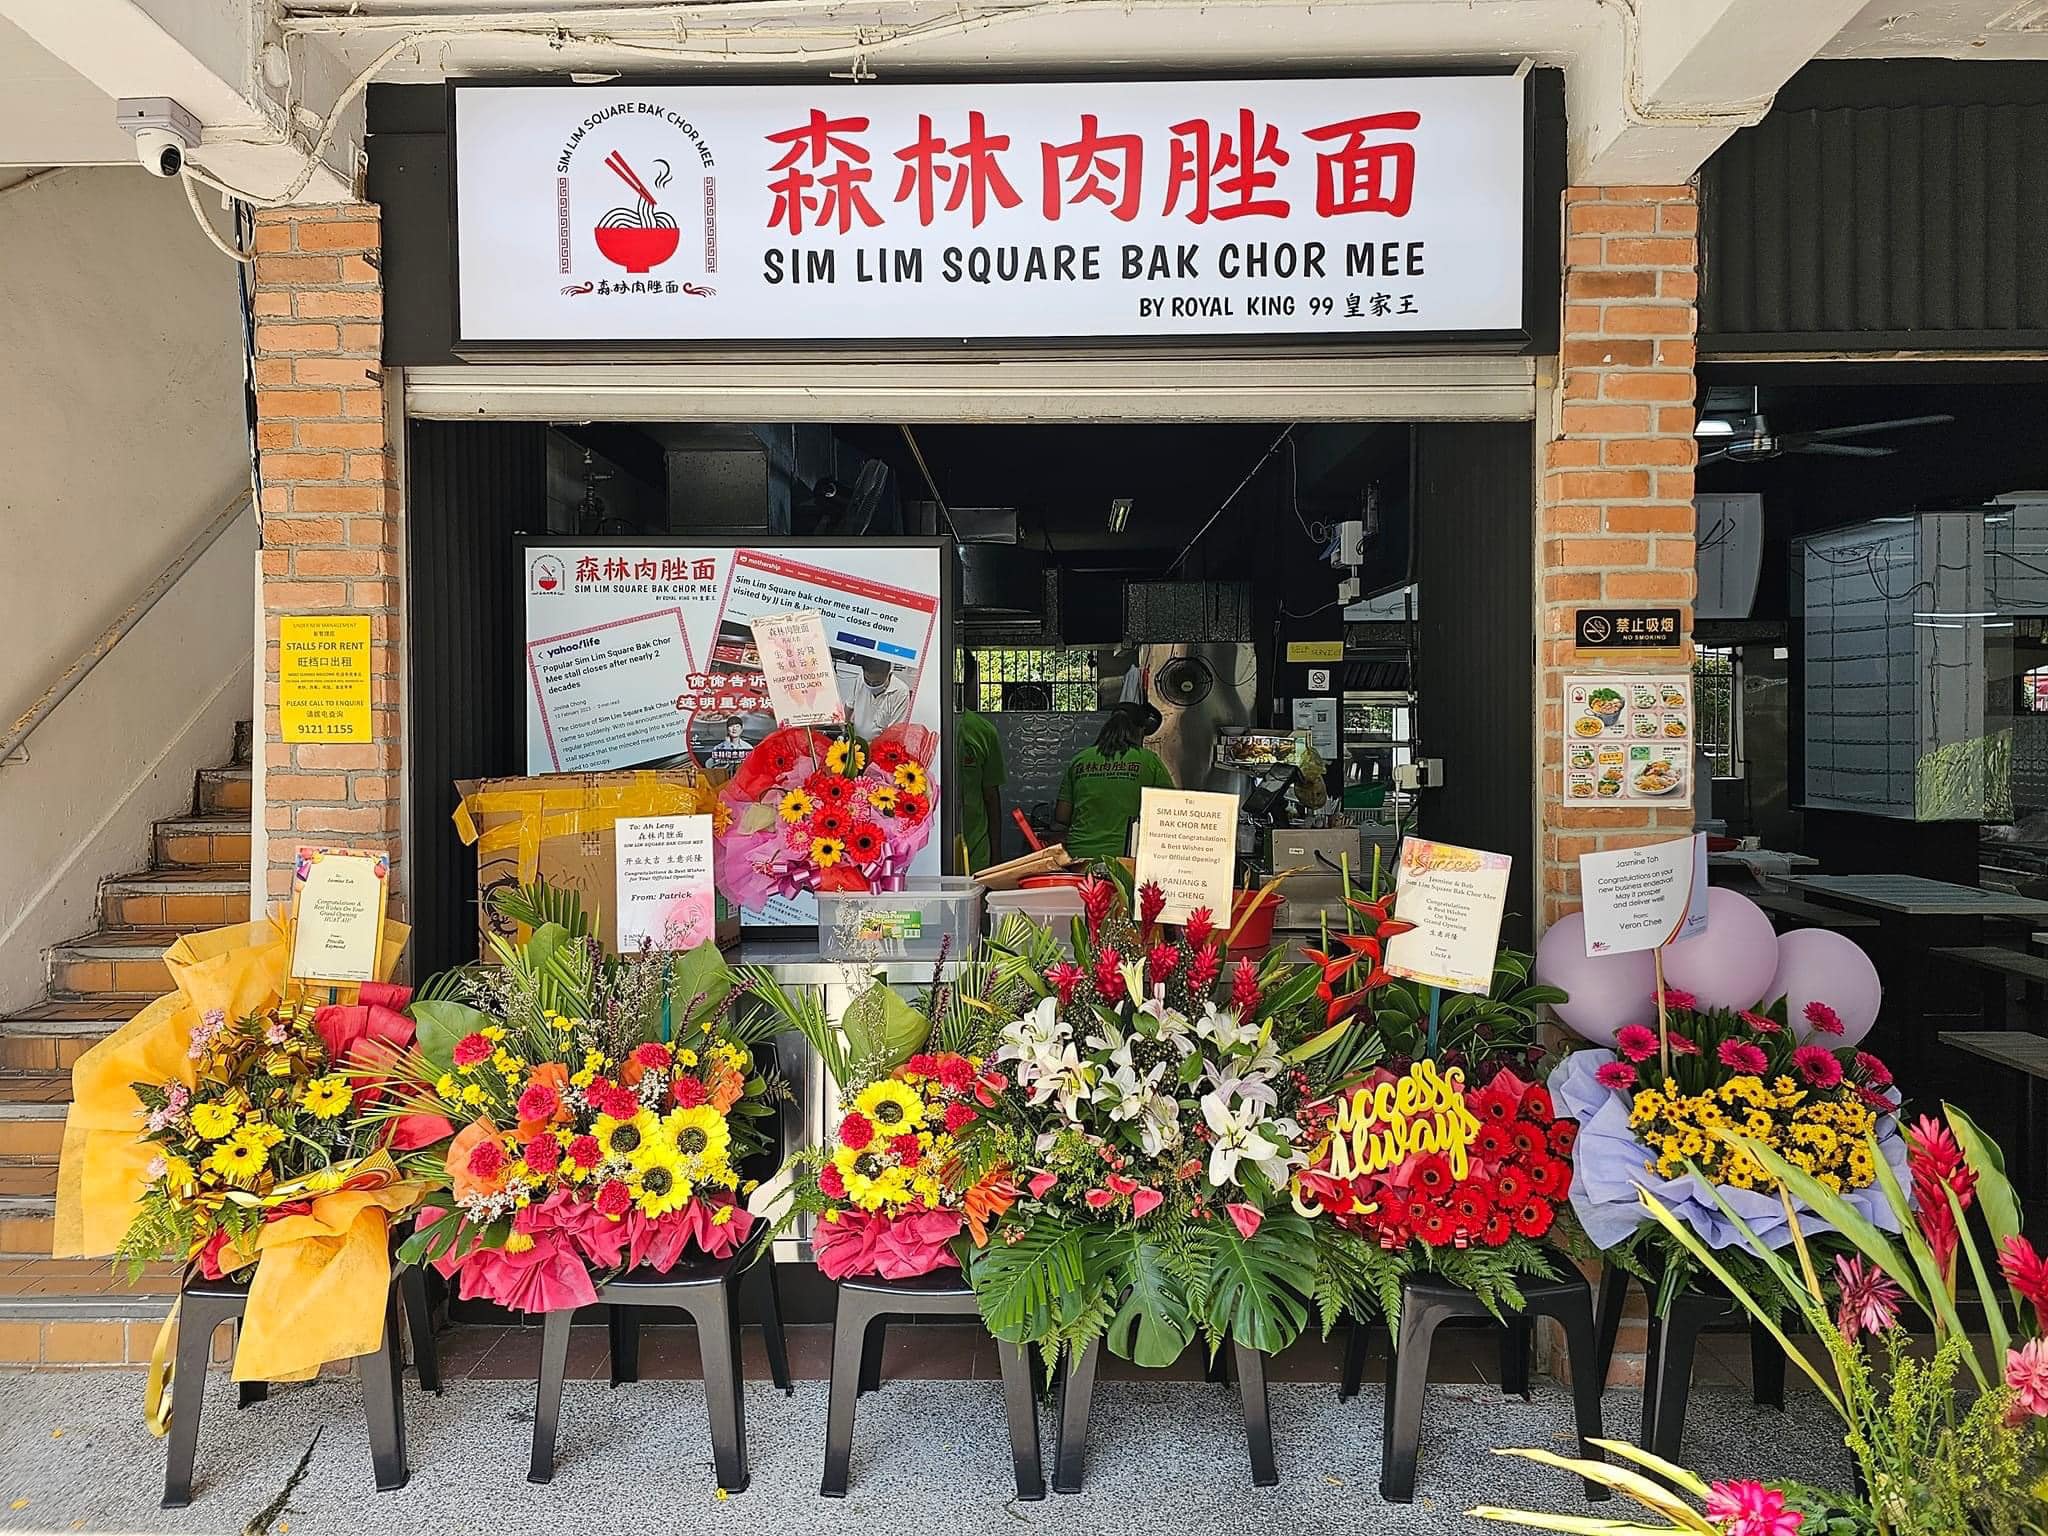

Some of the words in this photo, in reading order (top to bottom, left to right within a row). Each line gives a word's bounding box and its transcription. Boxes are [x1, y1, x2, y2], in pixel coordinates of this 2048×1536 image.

[558, 149, 573, 173] SIM
[566, 126, 587, 150] LIM
[583, 102, 635, 130] SQUARE
[638, 102, 665, 118] BAK
[667, 112, 699, 141] CHOR
[695, 140, 715, 168] MEE
[764, 108, 1421, 235] 森林肉脞面
[763, 248, 835, 284] SIM
[857, 247, 922, 283] LIM
[942, 245, 1100, 284] SQUARE
[1121, 243, 1199, 280] BAK
[1218, 241, 1326, 279] CHOR
[1346, 241, 1424, 277] MEE
[1139, 297, 1165, 317] BY
[1171, 296, 1234, 317] ROYAL
[1247, 295, 1295, 317] KING
[1309, 296, 1334, 316] 99
[1343, 292, 1419, 318] 皇家王
[574, 585, 591, 593] SIM
[595, 585, 610, 593] LIM
[613, 585, 648, 593] SQUARE
[651, 585, 669, 593] BAK
[672, 585, 696, 593] CHOR
[699, 585, 718, 593] MEE
[736, 575, 750, 585] Sim
[752, 578, 766, 589] Lim
[768, 583, 796, 599] Square
[798, 590, 812, 600] bak
[814, 594, 832, 606] chor
[834, 600, 850, 610] mee
[852, 603, 870, 616] stall
[878, 612, 898, 623] once
[733, 587, 760, 600] visited
[761, 593, 772, 604] by
[780, 598, 792, 608] Lin
[794, 602, 801, 610] &
[846, 614, 871, 627] closes
[872, 622, 894, 633] down
[1616, 618, 1674, 633] 禁止吸烟
[286, 642, 316, 650] STALLS
[318, 642, 337, 650] FOR
[340, 642, 364, 650] RENT
[543, 660, 573, 674] Popular
[574, 656, 590, 666] Sim
[591, 653, 606, 662] Lim
[607, 647, 636, 660] Square
[636, 641, 651, 651] Bak
[652, 636, 671, 647] Chor
[546, 674, 562, 684] Mee
[564, 669, 581, 680] stall
[582, 664, 608, 676] closes
[609, 658, 628, 670] after
[629, 652, 653, 665] nearly
[654, 650, 660, 658] 2
[548, 680, 581, 694] decades
[298, 724, 324, 734] 9121
[326, 724, 353, 734] 1155
[1156, 808, 1172, 816] SIM
[1174, 808, 1188, 817] LIM
[1189, 810, 1221, 819] SQUARE
[656, 822, 674, 830] Leng
[1160, 820, 1175, 828] BAK
[1176, 821, 1198, 830] CHOR
[1200, 822, 1218, 830] MEE
[1150, 832, 1177, 840] Heartiest
[1178, 833, 1226, 843] Congratulations
[1182, 844, 1204, 852] Wishes
[1616, 858, 1646, 868] Jasmine
[1647, 856, 1658, 864] Toh
[1598, 873, 1651, 885] Congratulations
[1660, 868, 1674, 877] your
[1162, 878, 1200, 887] PANJANG
[1615, 883, 1642, 892] business
[631, 894, 656, 902] From:
[658, 892, 692, 900] Patrick
[1178, 891, 1205, 900] CHENG
[1638, 888, 1662, 898] prosper
[1628, 898, 1651, 907] deliver
[1619, 921, 1642, 930] Veron
[1642, 918, 1662, 927] Chee
[1308, 1059, 1466, 1140] uccess
